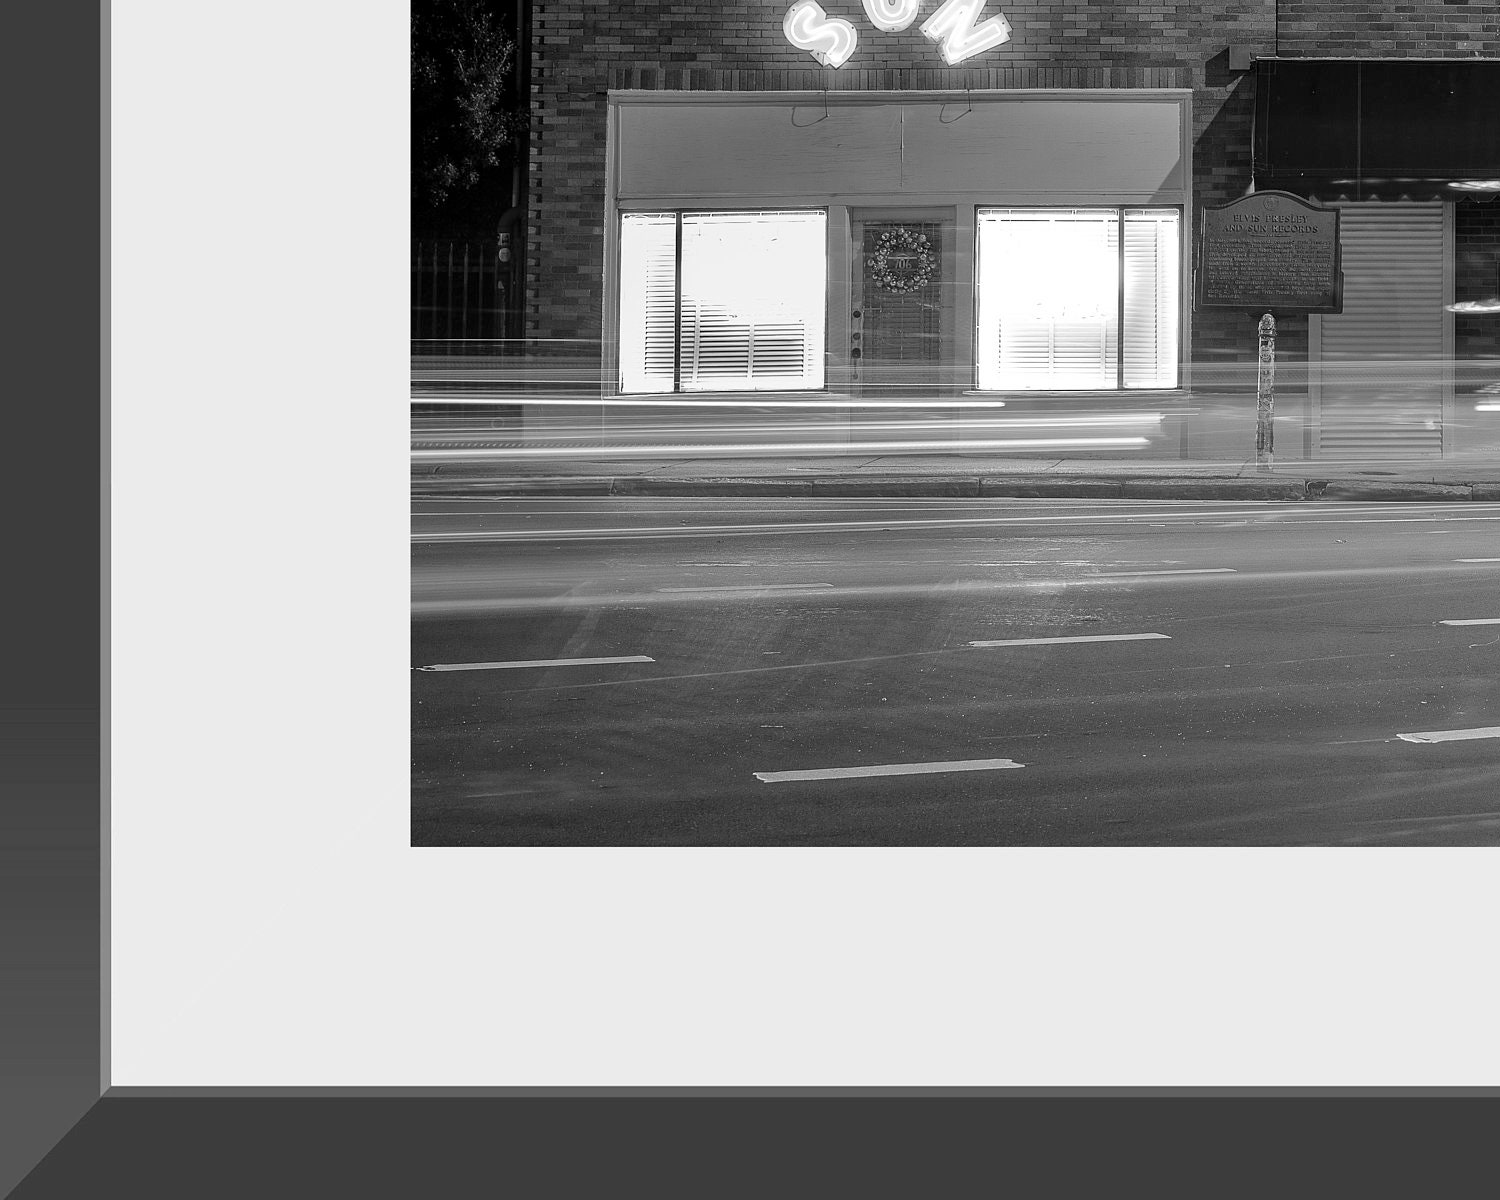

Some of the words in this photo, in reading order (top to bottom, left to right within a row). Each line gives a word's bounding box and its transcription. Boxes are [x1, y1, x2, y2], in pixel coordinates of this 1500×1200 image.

[1233, 214, 1260, 223] ELVIS
[1265, 214, 1308, 224] PRESLEY
[1222, 224, 1243, 233] AND
[1247, 224, 1267, 233] SUN
[1271, 225, 1319, 234] RECORDS
[894, 258, 912, 270] 706
